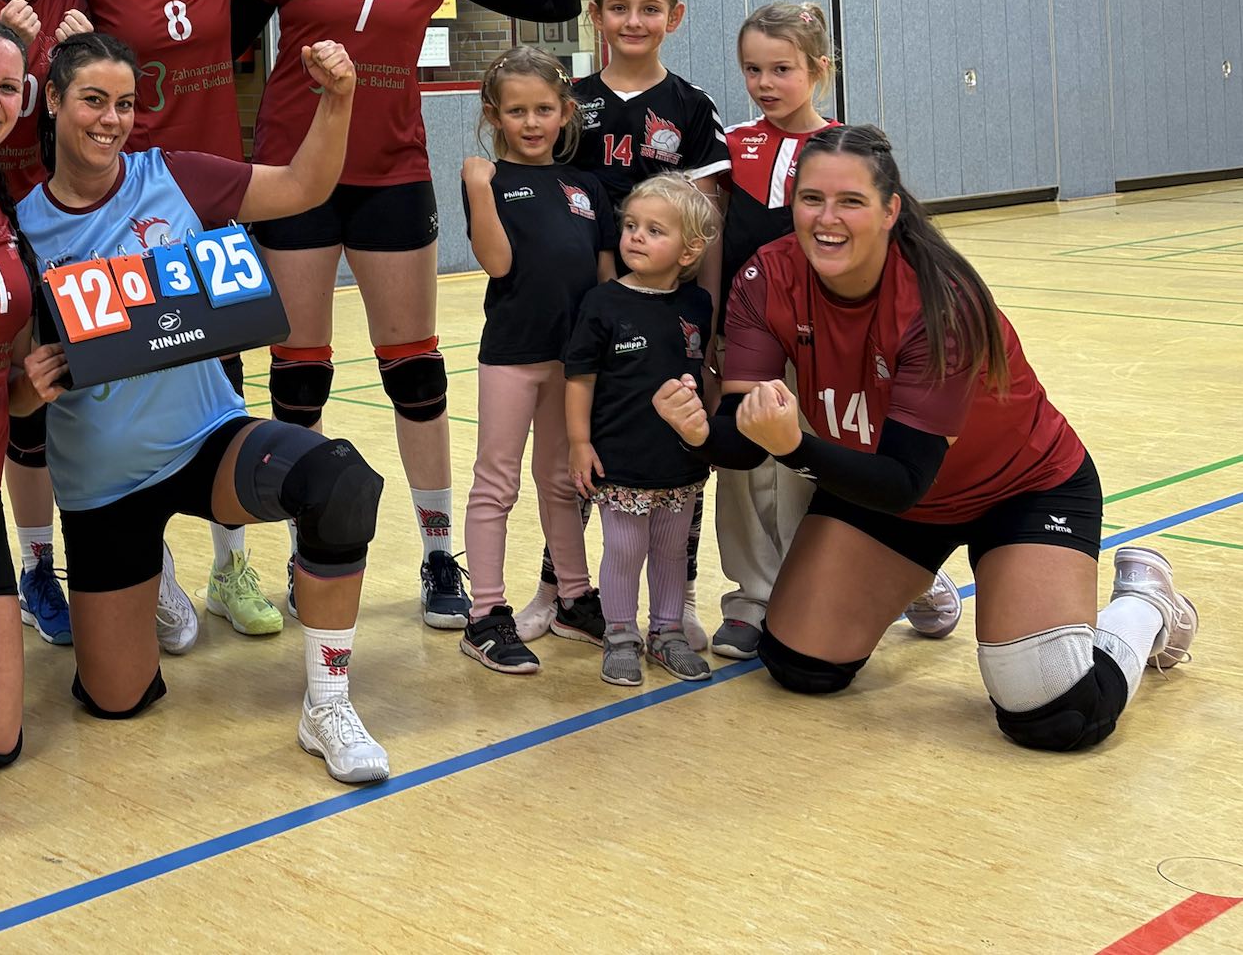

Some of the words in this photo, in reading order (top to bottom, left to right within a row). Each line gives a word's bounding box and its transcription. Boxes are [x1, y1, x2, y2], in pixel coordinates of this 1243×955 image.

[164, 0, 192, 41] 8
[173, 82, 201, 95] Anne
[604, 134, 633, 166] 14
[503, 189, 530, 200] Philipp
[57, 268, 124, 331] 12
[122, 271, 147, 302] 0
[166, 260, 191, 291] 3
[195, 233, 263, 296] 25
[148, 328, 206, 351] XINJING
[614, 341, 642, 351] Philipp
[818, 388, 875, 445] 14
[1044, 523, 1073, 534] erima
